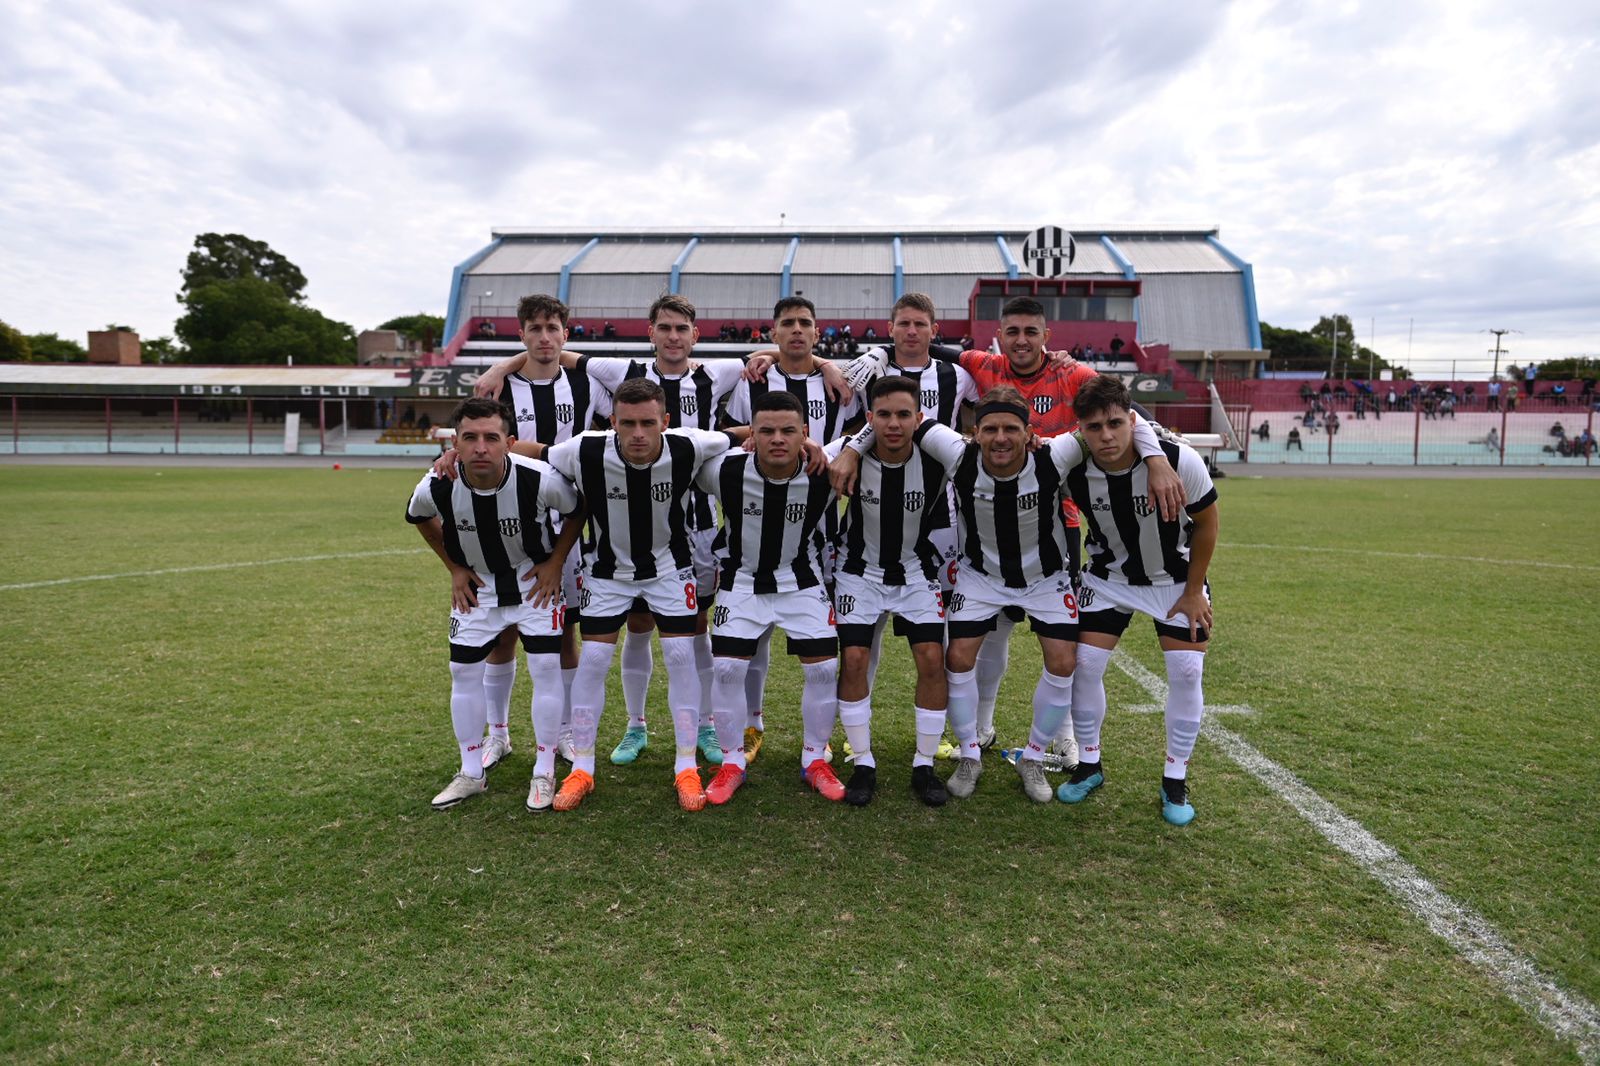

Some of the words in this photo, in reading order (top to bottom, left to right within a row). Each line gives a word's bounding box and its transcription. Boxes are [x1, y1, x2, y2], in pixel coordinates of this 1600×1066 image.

[1030, 248, 1067, 258] BELL
[180, 386, 241, 395] 1904
[300, 386, 370, 395] CLUB
[419, 386, 468, 397] BEL
[947, 560, 958, 585] 6
[684, 582, 697, 610] 8
[1063, 593, 1077, 619] 9
